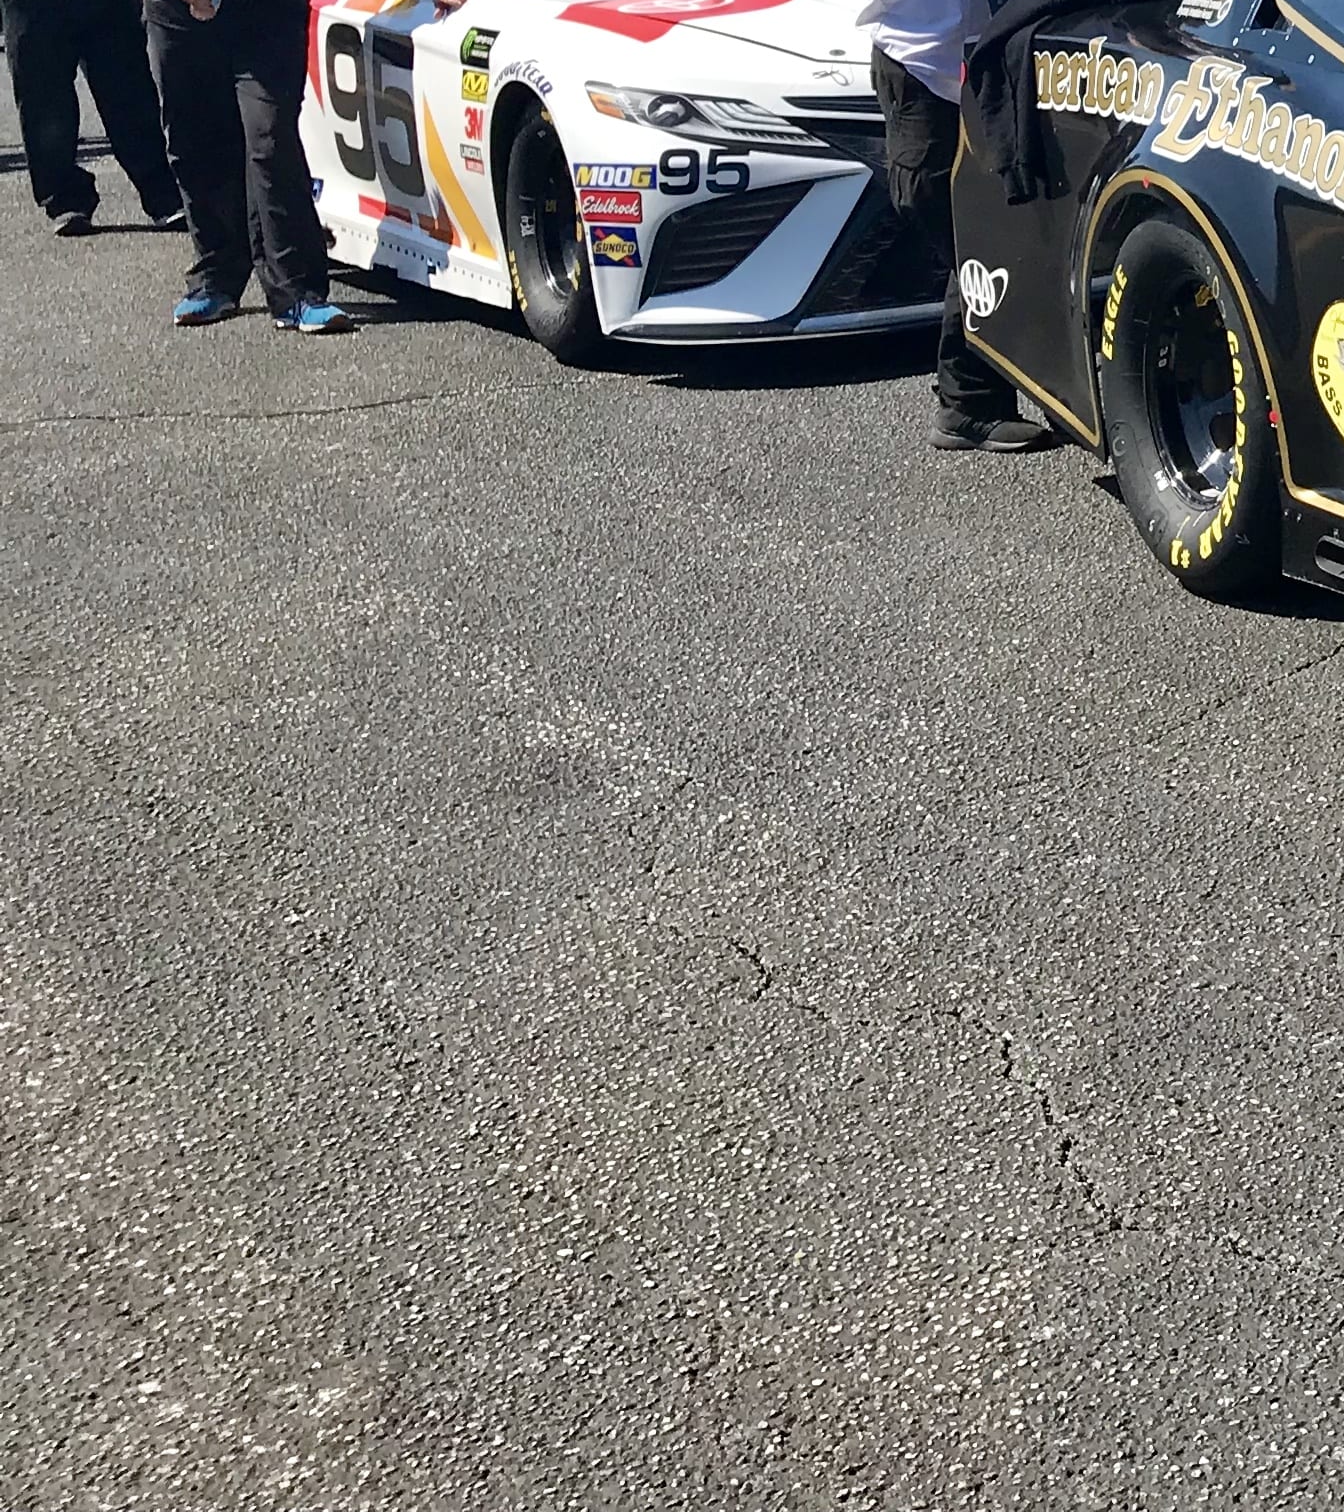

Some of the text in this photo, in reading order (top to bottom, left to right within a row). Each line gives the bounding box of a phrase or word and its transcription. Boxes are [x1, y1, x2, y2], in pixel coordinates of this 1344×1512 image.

[325, 23, 428, 199] 95
[1034, 37, 1164, 126] merican
[576, 164, 652, 187] MOOG
[658, 149, 750, 196] 95
[582, 194, 640, 217] Edelbrock
[594, 241, 635, 255] SUNOCO
[1102, 263, 1128, 361] EAGLE
[1317, 355, 1343, 417] BASS
[1199, 330, 1246, 560] GOODYEAR
